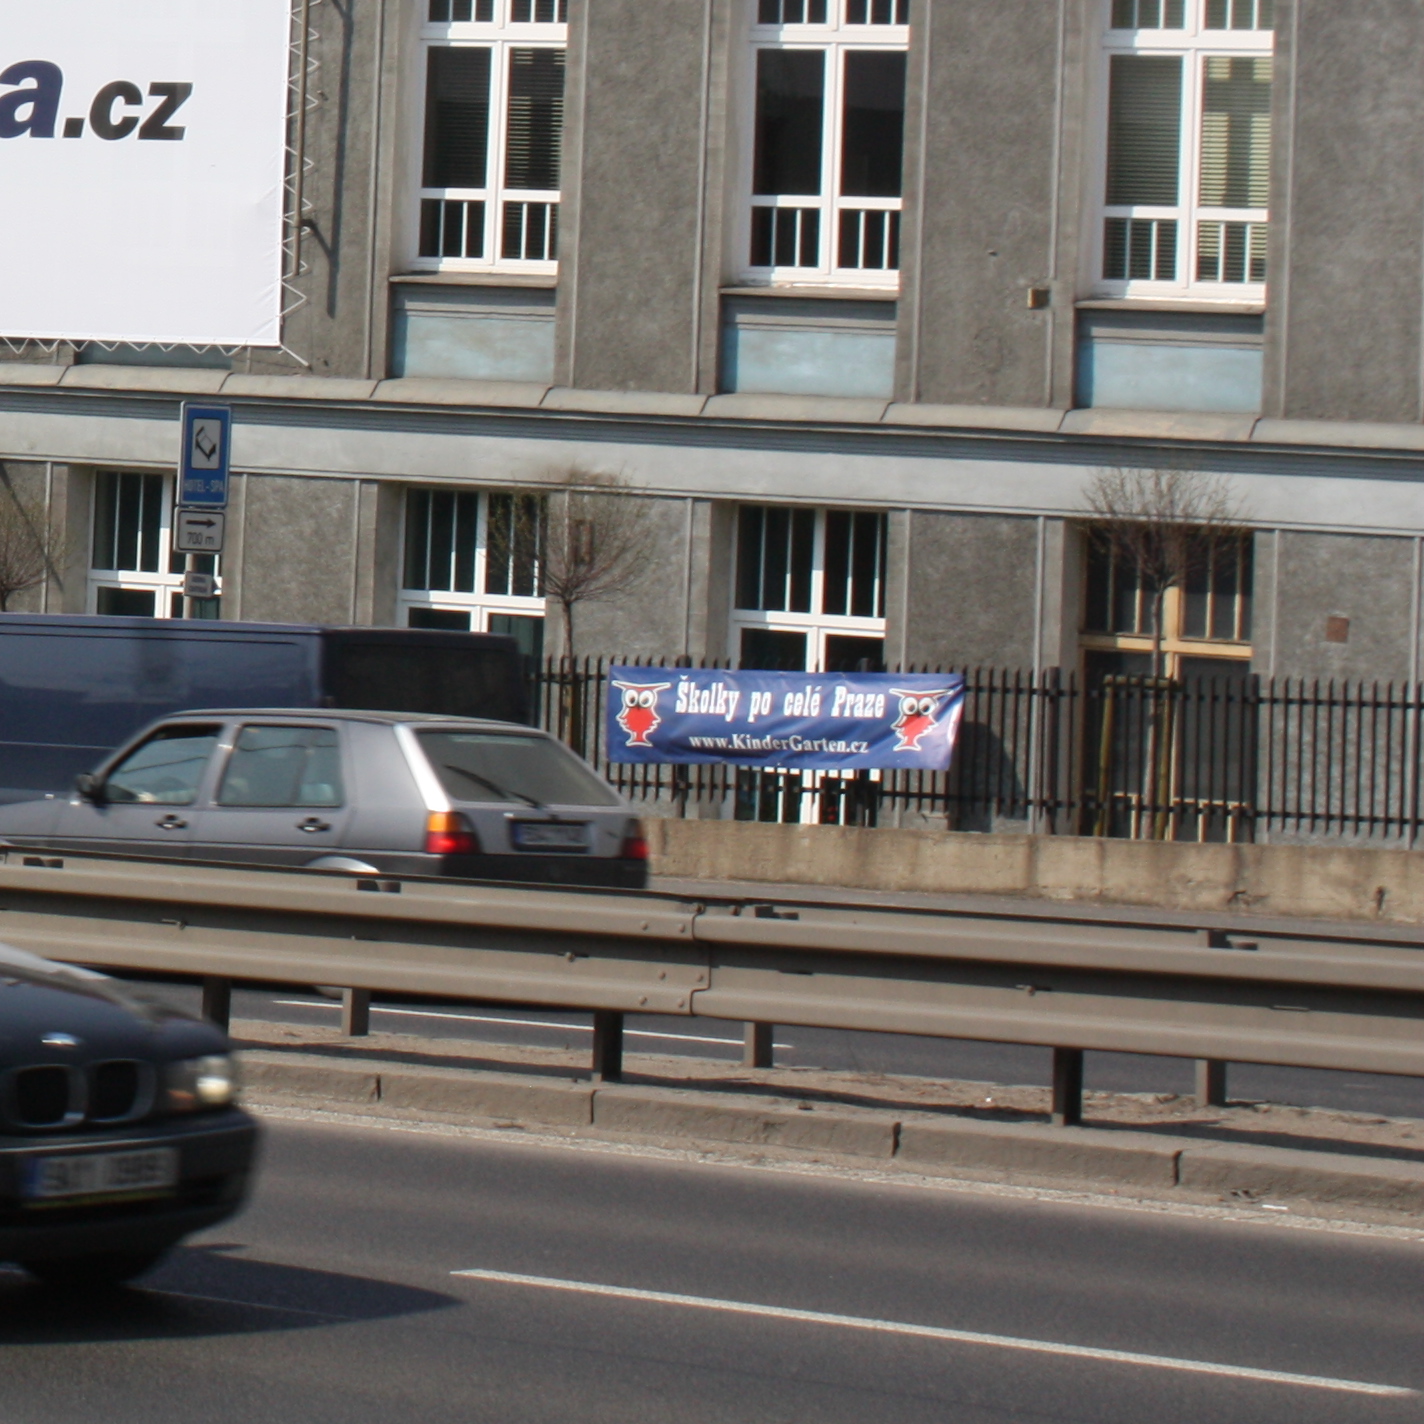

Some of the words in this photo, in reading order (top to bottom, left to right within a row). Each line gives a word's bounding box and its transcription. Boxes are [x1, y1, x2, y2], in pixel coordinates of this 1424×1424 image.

[675, 675, 740, 722] Školky
[747, 690, 771, 723] po
[783, 685, 823, 717] celé
[831, 685, 885, 718] Praze
[688, 733, 869, 754] www.KinderGarten.cz
